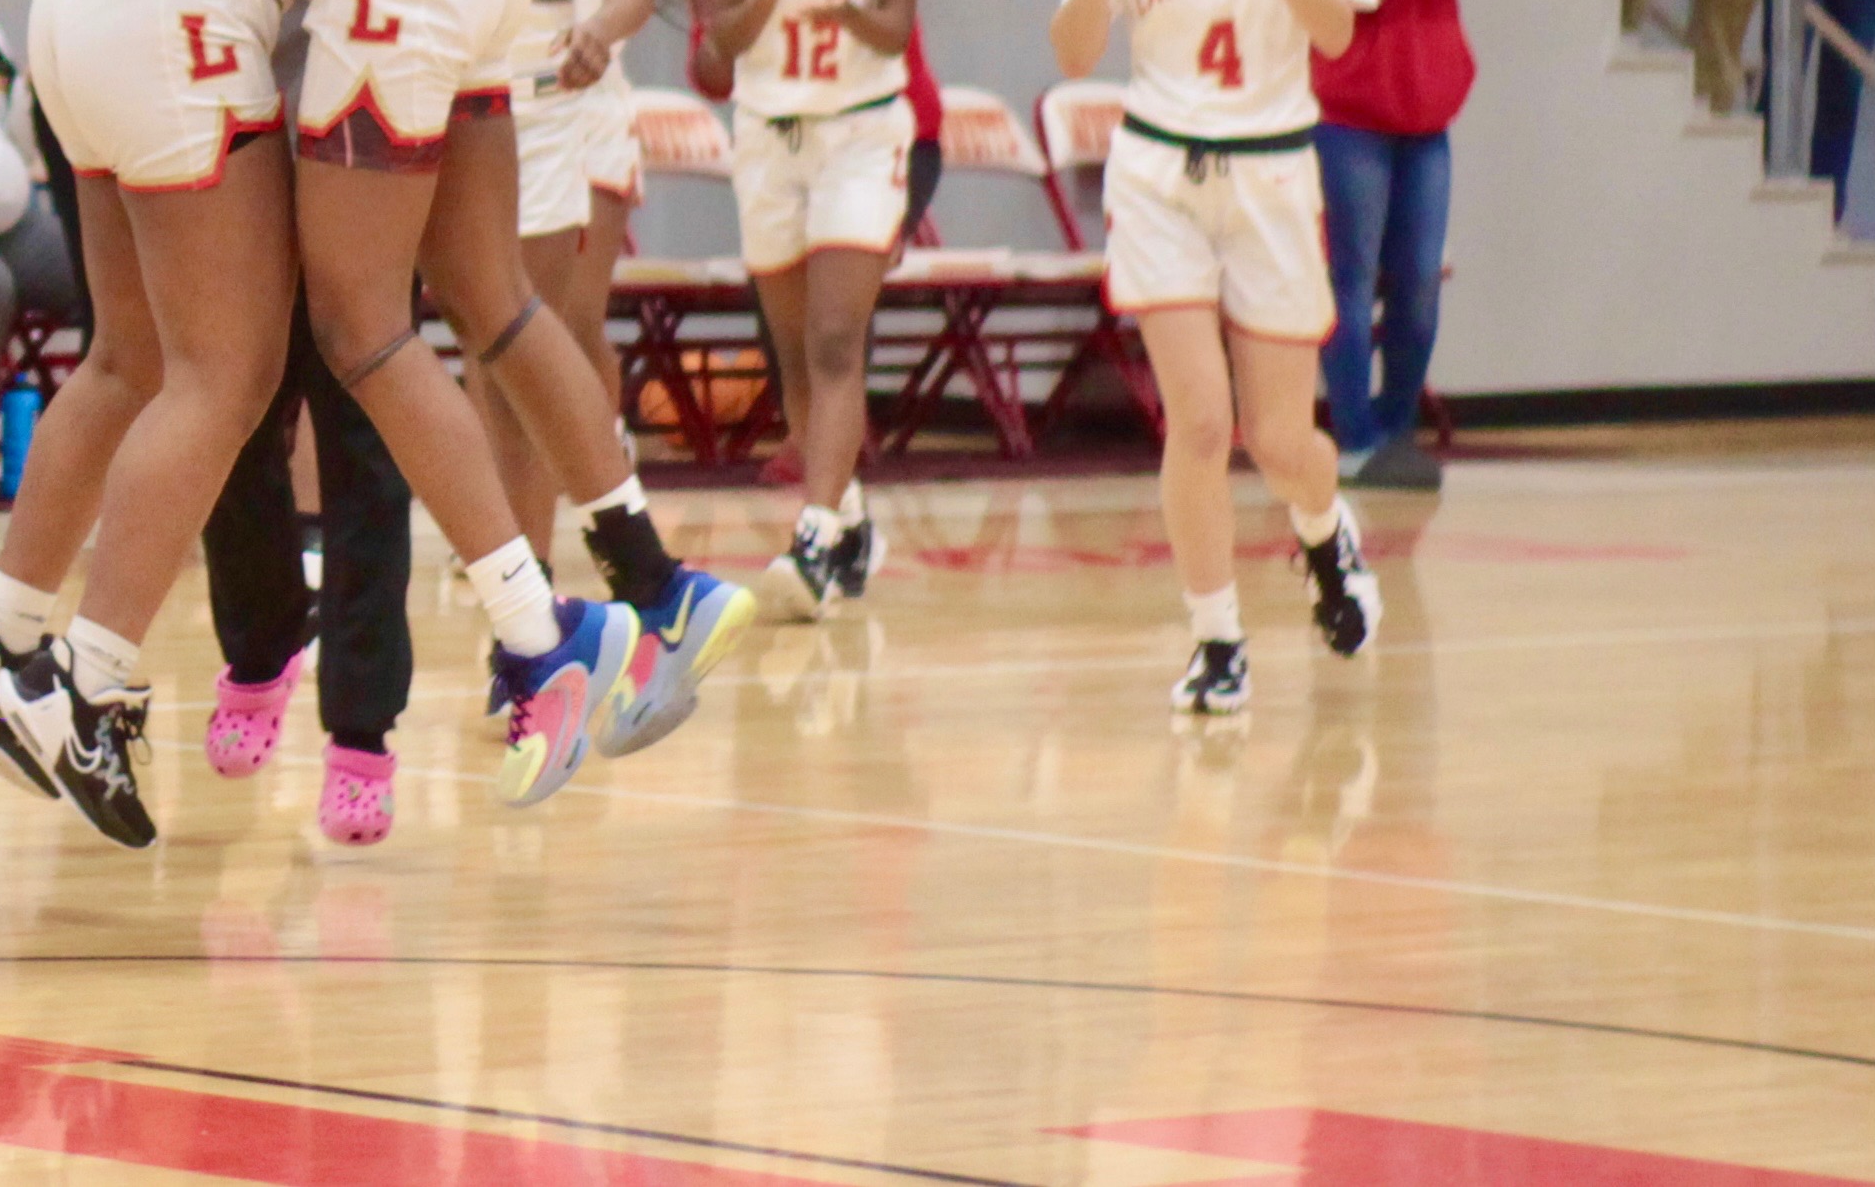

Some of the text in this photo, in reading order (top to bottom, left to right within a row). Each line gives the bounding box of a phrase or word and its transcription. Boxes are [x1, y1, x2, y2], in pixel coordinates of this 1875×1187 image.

[180, 14, 240, 83] L
[781, 16, 840, 81] 12
[1198, 19, 1244, 88] 4
